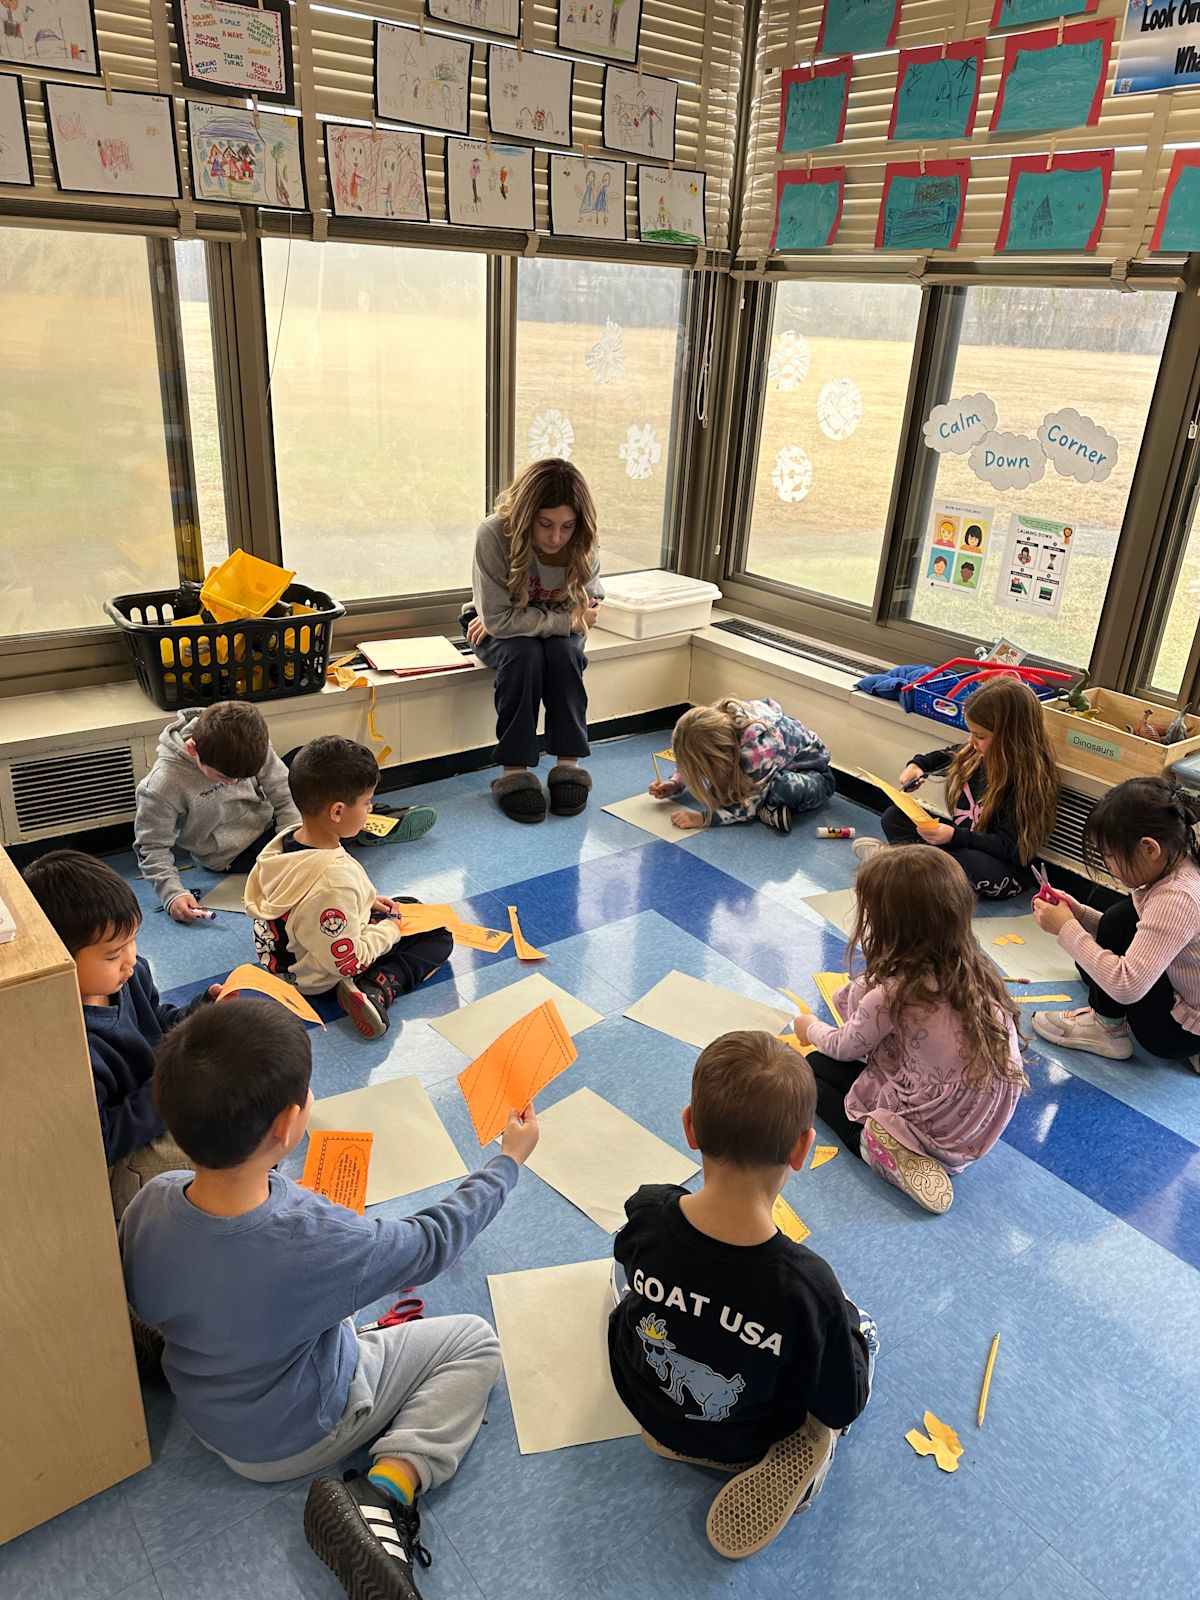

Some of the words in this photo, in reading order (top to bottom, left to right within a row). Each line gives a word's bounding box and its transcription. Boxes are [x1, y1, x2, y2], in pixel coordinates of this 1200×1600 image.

[224, 18, 241, 26] SMILE
[1140, 0, 1176, 32] Look
[939, 412, 982, 439] Calm
[1047, 425, 1107, 465] Corner
[985, 450, 1029, 468] Down
[1017, 528, 1038, 537] CALMING
[1073, 736, 1114, 756] Dinosaurs
[634, 1268, 711, 1317] GOAT
[719, 1306, 783, 1356] USA
